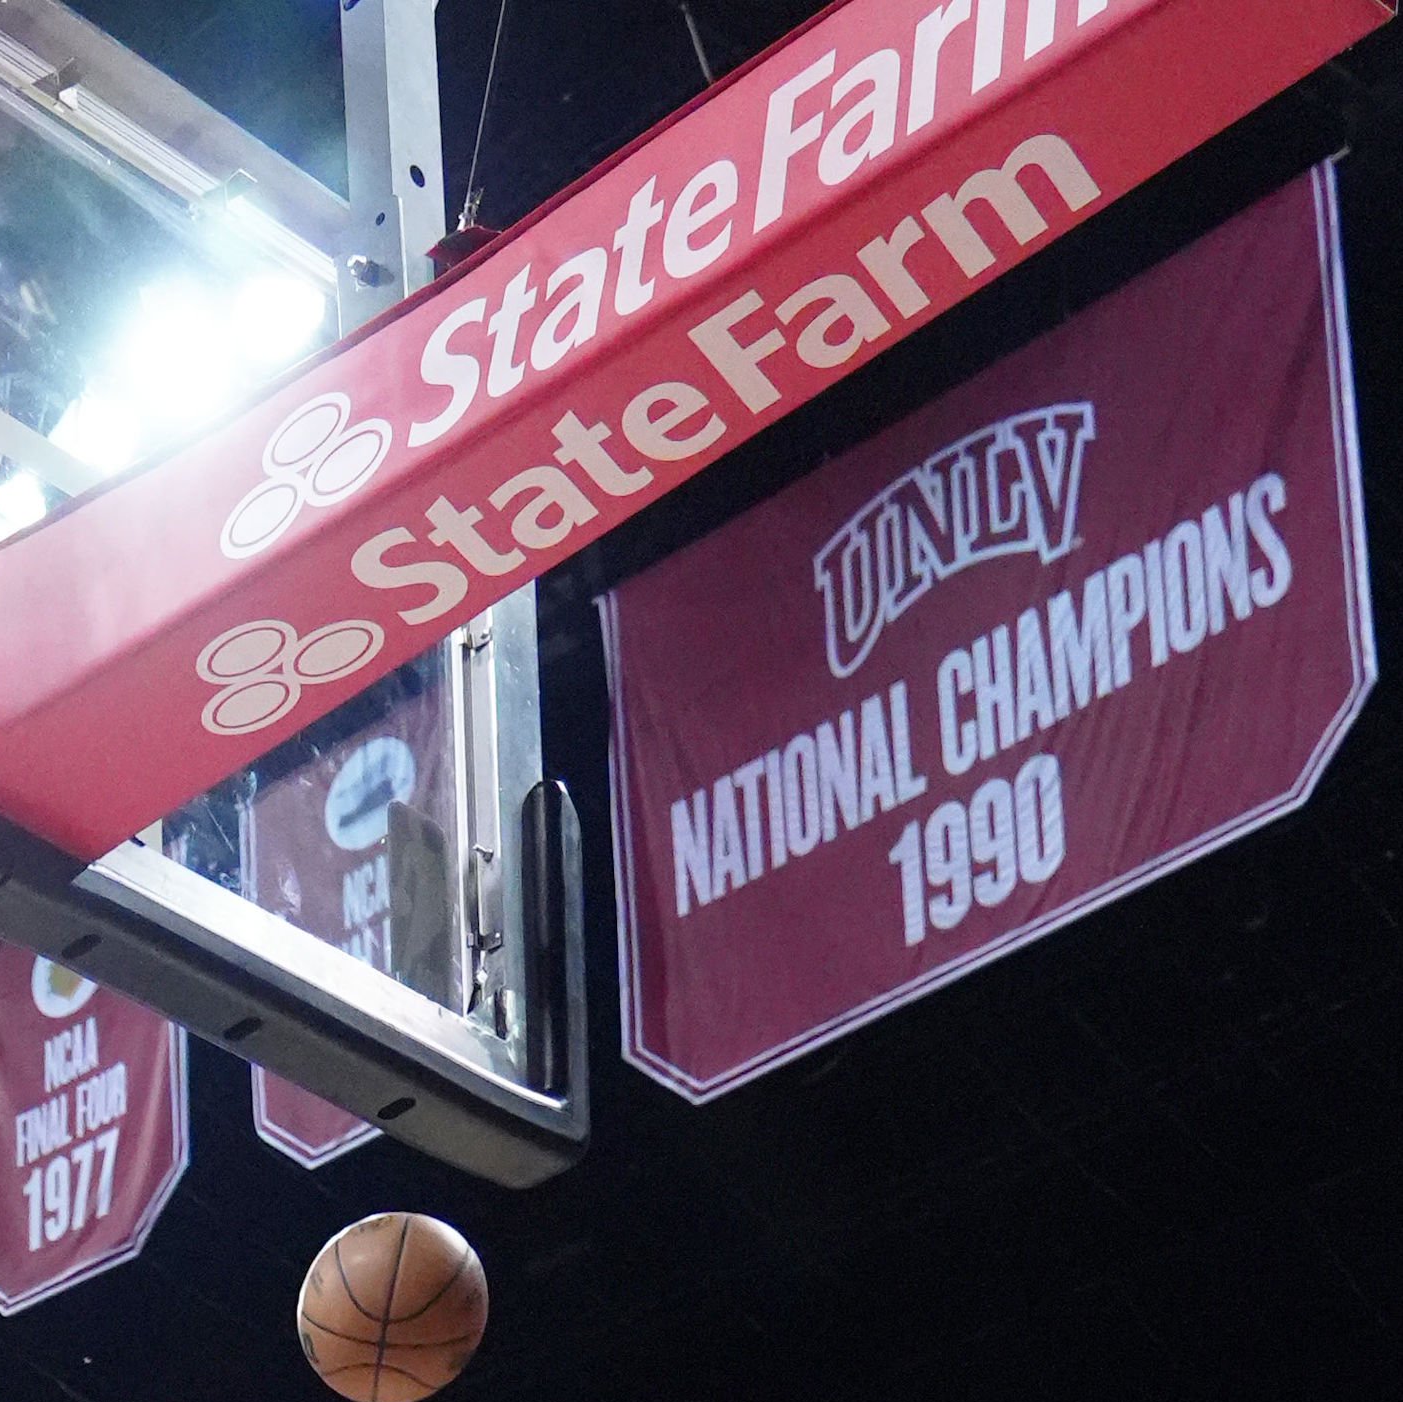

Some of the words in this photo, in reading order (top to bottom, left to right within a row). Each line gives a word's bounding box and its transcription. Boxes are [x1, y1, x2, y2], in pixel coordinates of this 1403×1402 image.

[813, 400, 1095, 679] UNLV
[670, 679, 927, 918] NATIONAL
[937, 471, 1293, 775] CHAMPIONS
[888, 752, 1067, 947] 1990
[15, 1092, 72, 1168] FINAL
[75, 1060, 128, 1138] FOUR
[44, 1015, 98, 1093] NCAA
[22, 1126, 120, 1252] 1977
